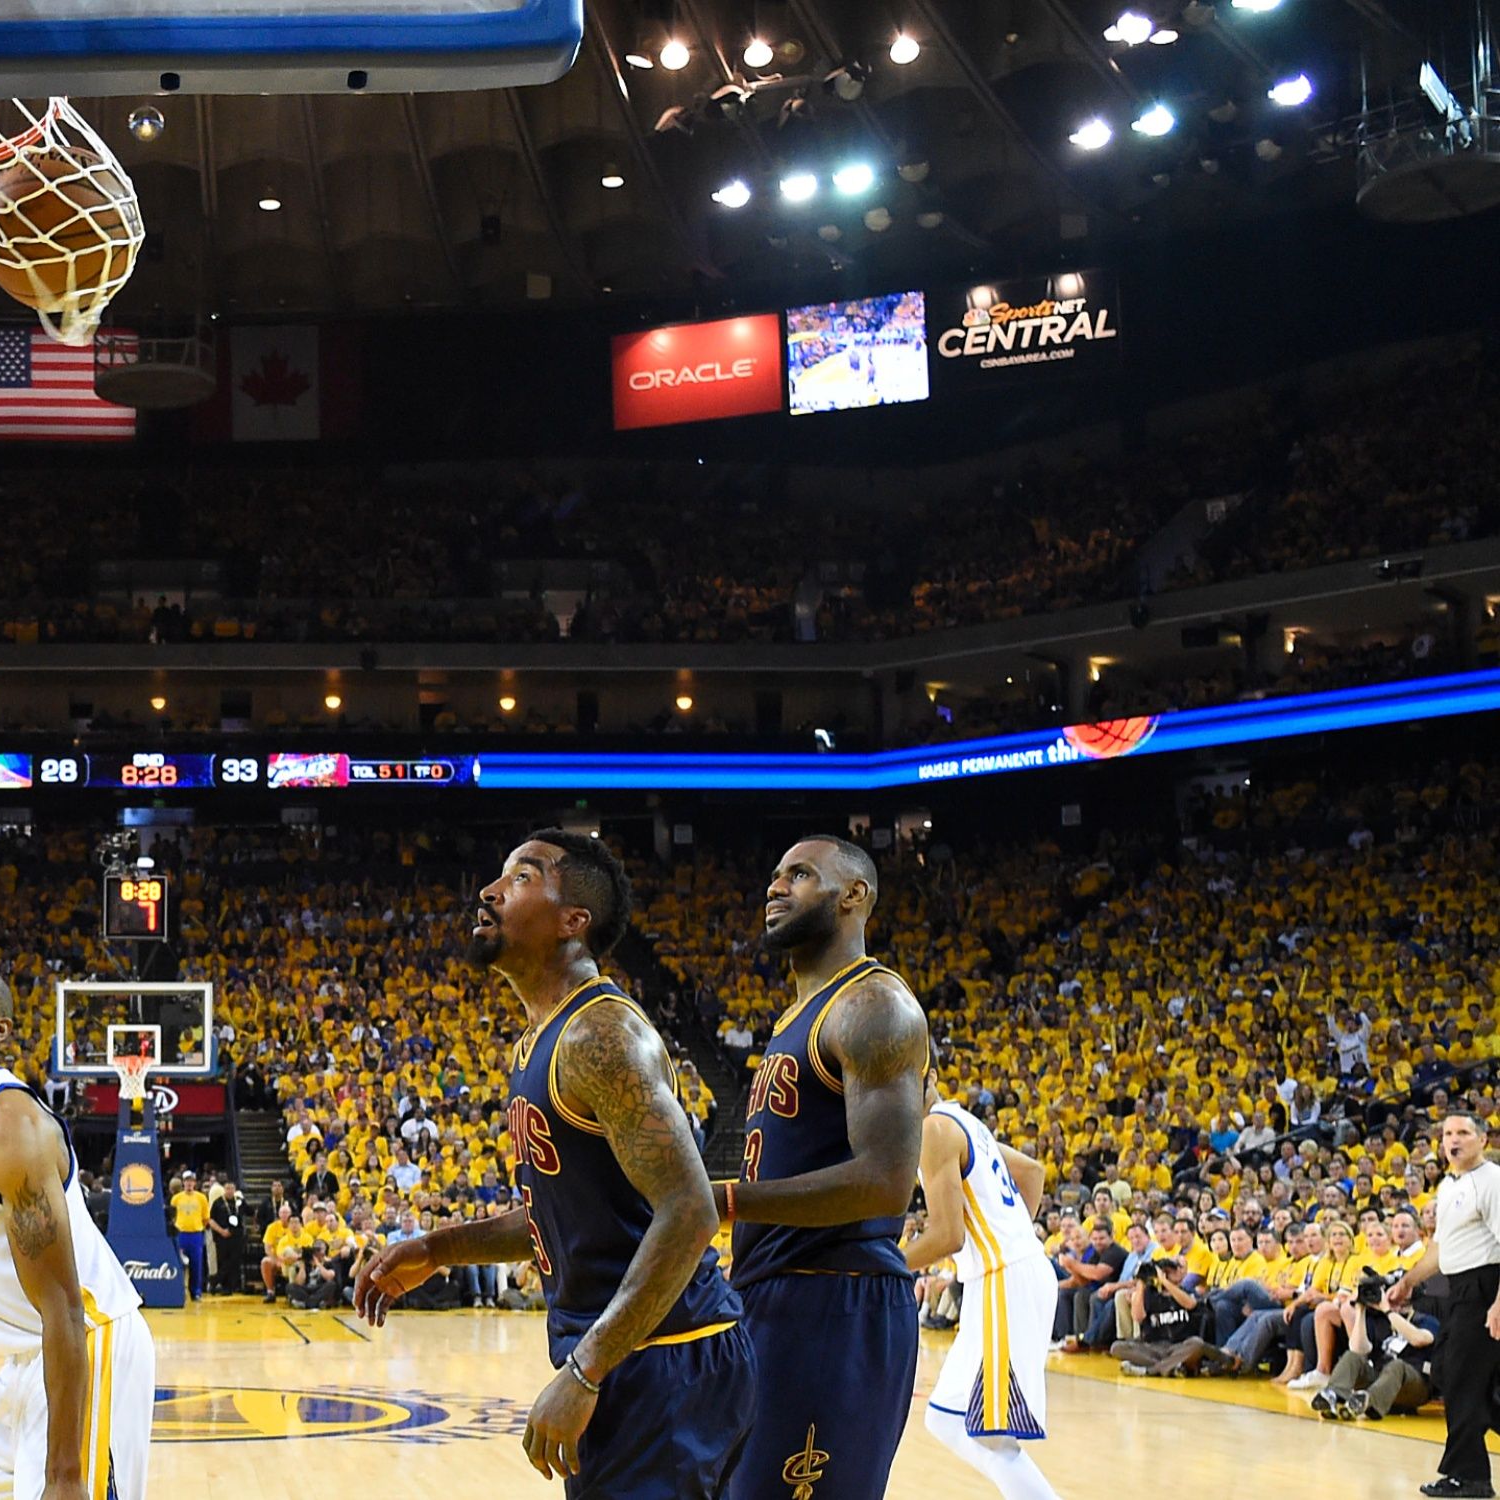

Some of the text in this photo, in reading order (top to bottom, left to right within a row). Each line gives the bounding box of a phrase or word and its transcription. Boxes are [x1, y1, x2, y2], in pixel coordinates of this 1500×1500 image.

[938, 309, 1117, 358] CENTRAL
[629, 358, 754, 391] ORACLE
[40, 758, 78, 783] 28
[121, 765, 178, 786] 8:28
[221, 758, 259, 783] 33
[918, 761, 959, 780] KAISER
[961, 749, 1043, 774] PERMANENTE
[120, 880, 162, 902] 8:28
[137, 900, 156, 932] 7
[745, 1052, 799, 1119] AVS
[507, 1095, 561, 1176] AVS
[123, 1260, 178, 1280] Finals
